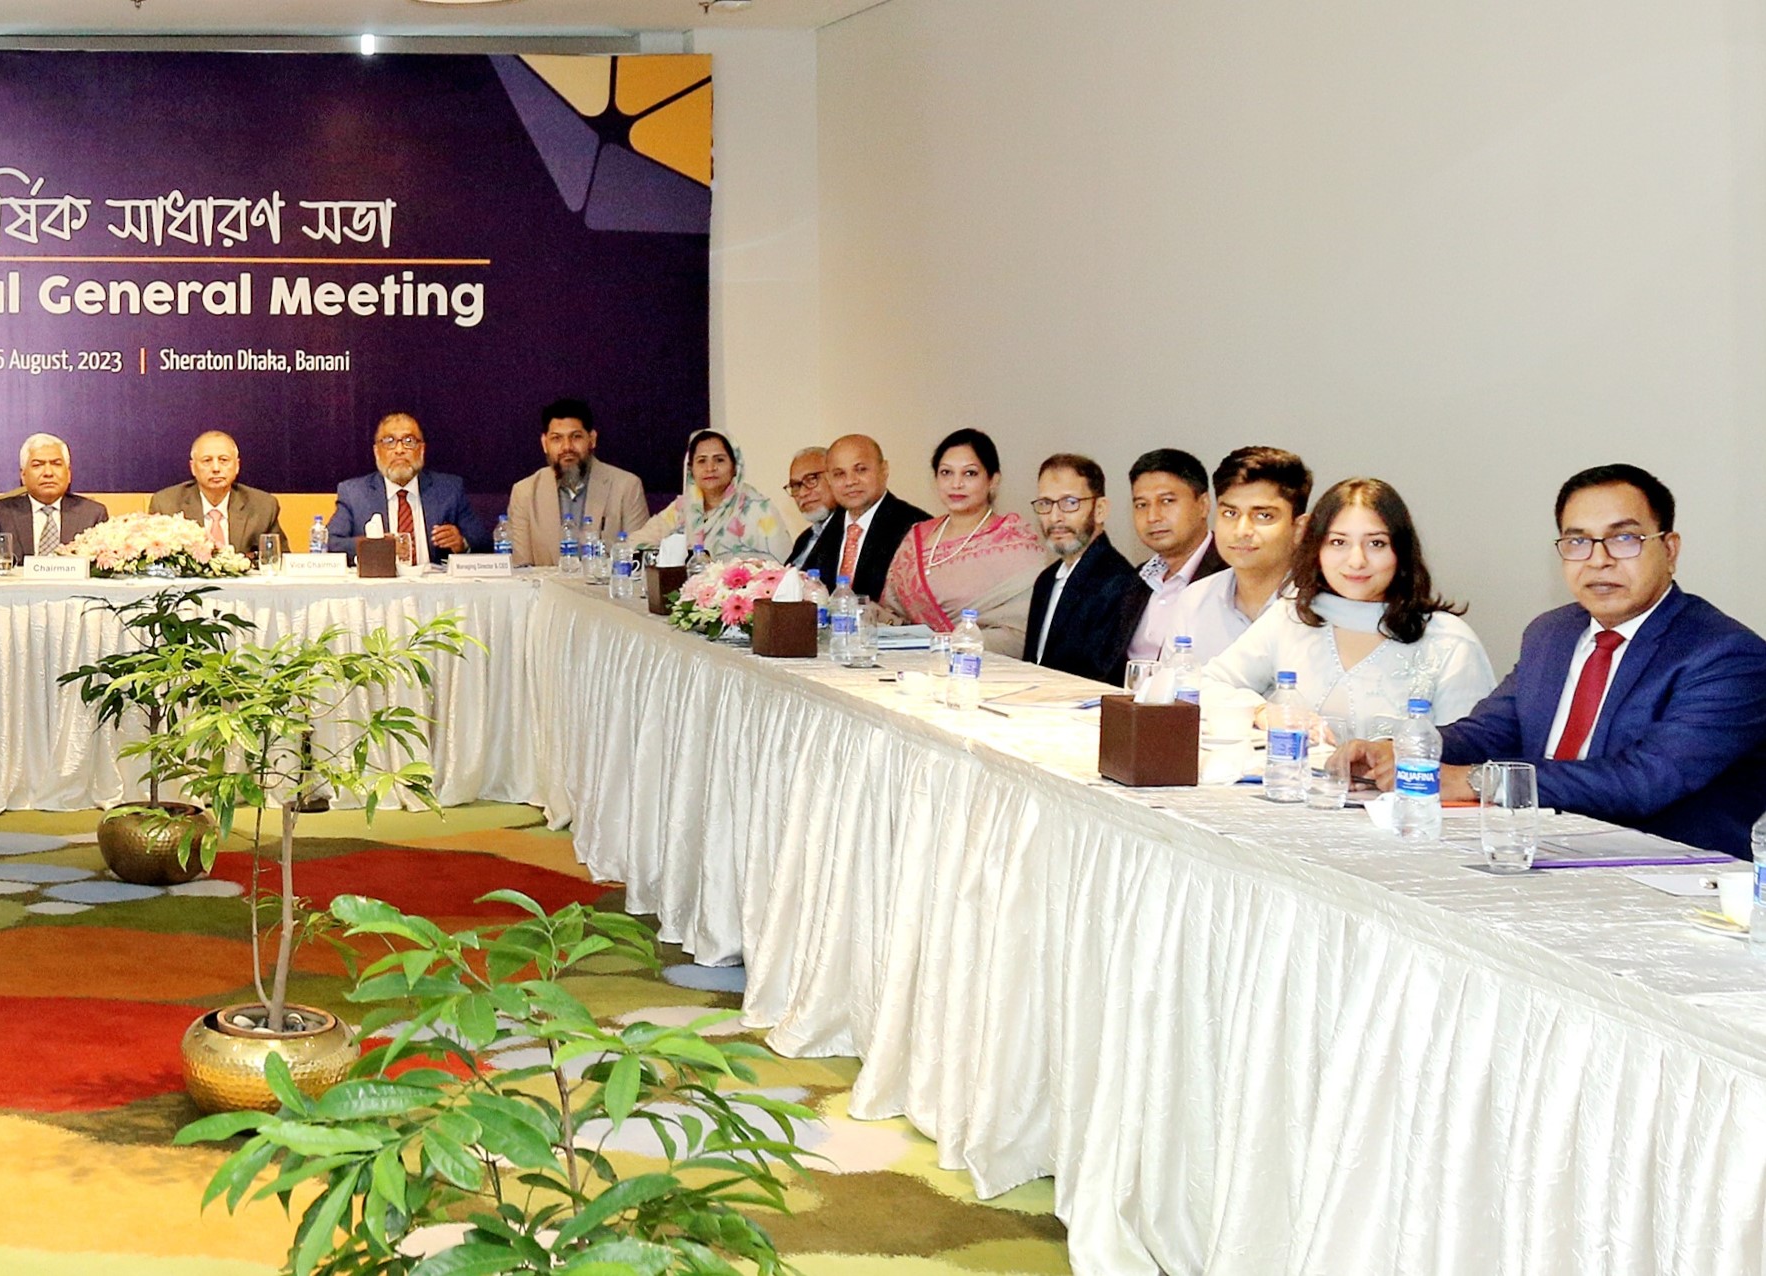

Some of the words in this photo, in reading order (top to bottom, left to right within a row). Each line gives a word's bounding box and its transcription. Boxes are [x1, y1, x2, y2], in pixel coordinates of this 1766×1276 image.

[105, 189, 286, 247] সাধারণ
[299, 198, 397, 249] সভা
[38, 272, 252, 315] General
[269, 271, 484, 327] Meeting
[8, 349, 74, 374] August,
[77, 351, 123, 373] 2023
[160, 348, 234, 371] Sheraton
[237, 348, 292, 374] Dhaka,
[295, 348, 350, 371] Banani
[33, 564, 76, 572] Chairman
